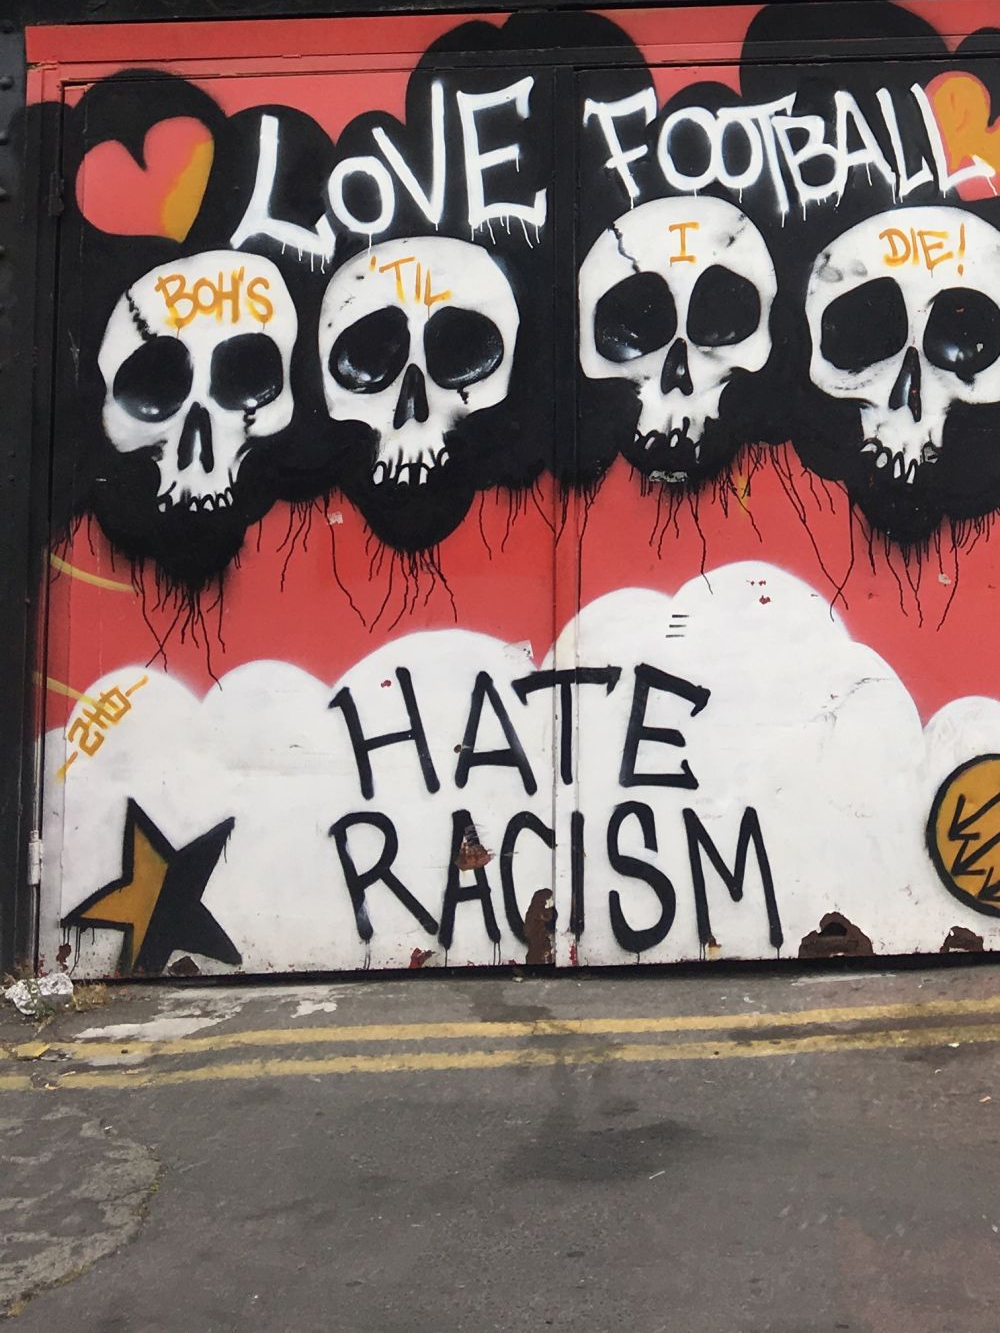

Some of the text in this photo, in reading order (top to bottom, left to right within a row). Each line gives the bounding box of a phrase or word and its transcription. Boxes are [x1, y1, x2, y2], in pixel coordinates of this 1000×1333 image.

[231, 76, 995, 260] LOVE FOOTBALL
[669, 221, 700, 266] I
[879, 222, 967, 277] DIE!
[155, 266, 273, 329] BOH'S
[328, 662, 712, 800] HATE
[328, 800, 785, 954] RACISM
